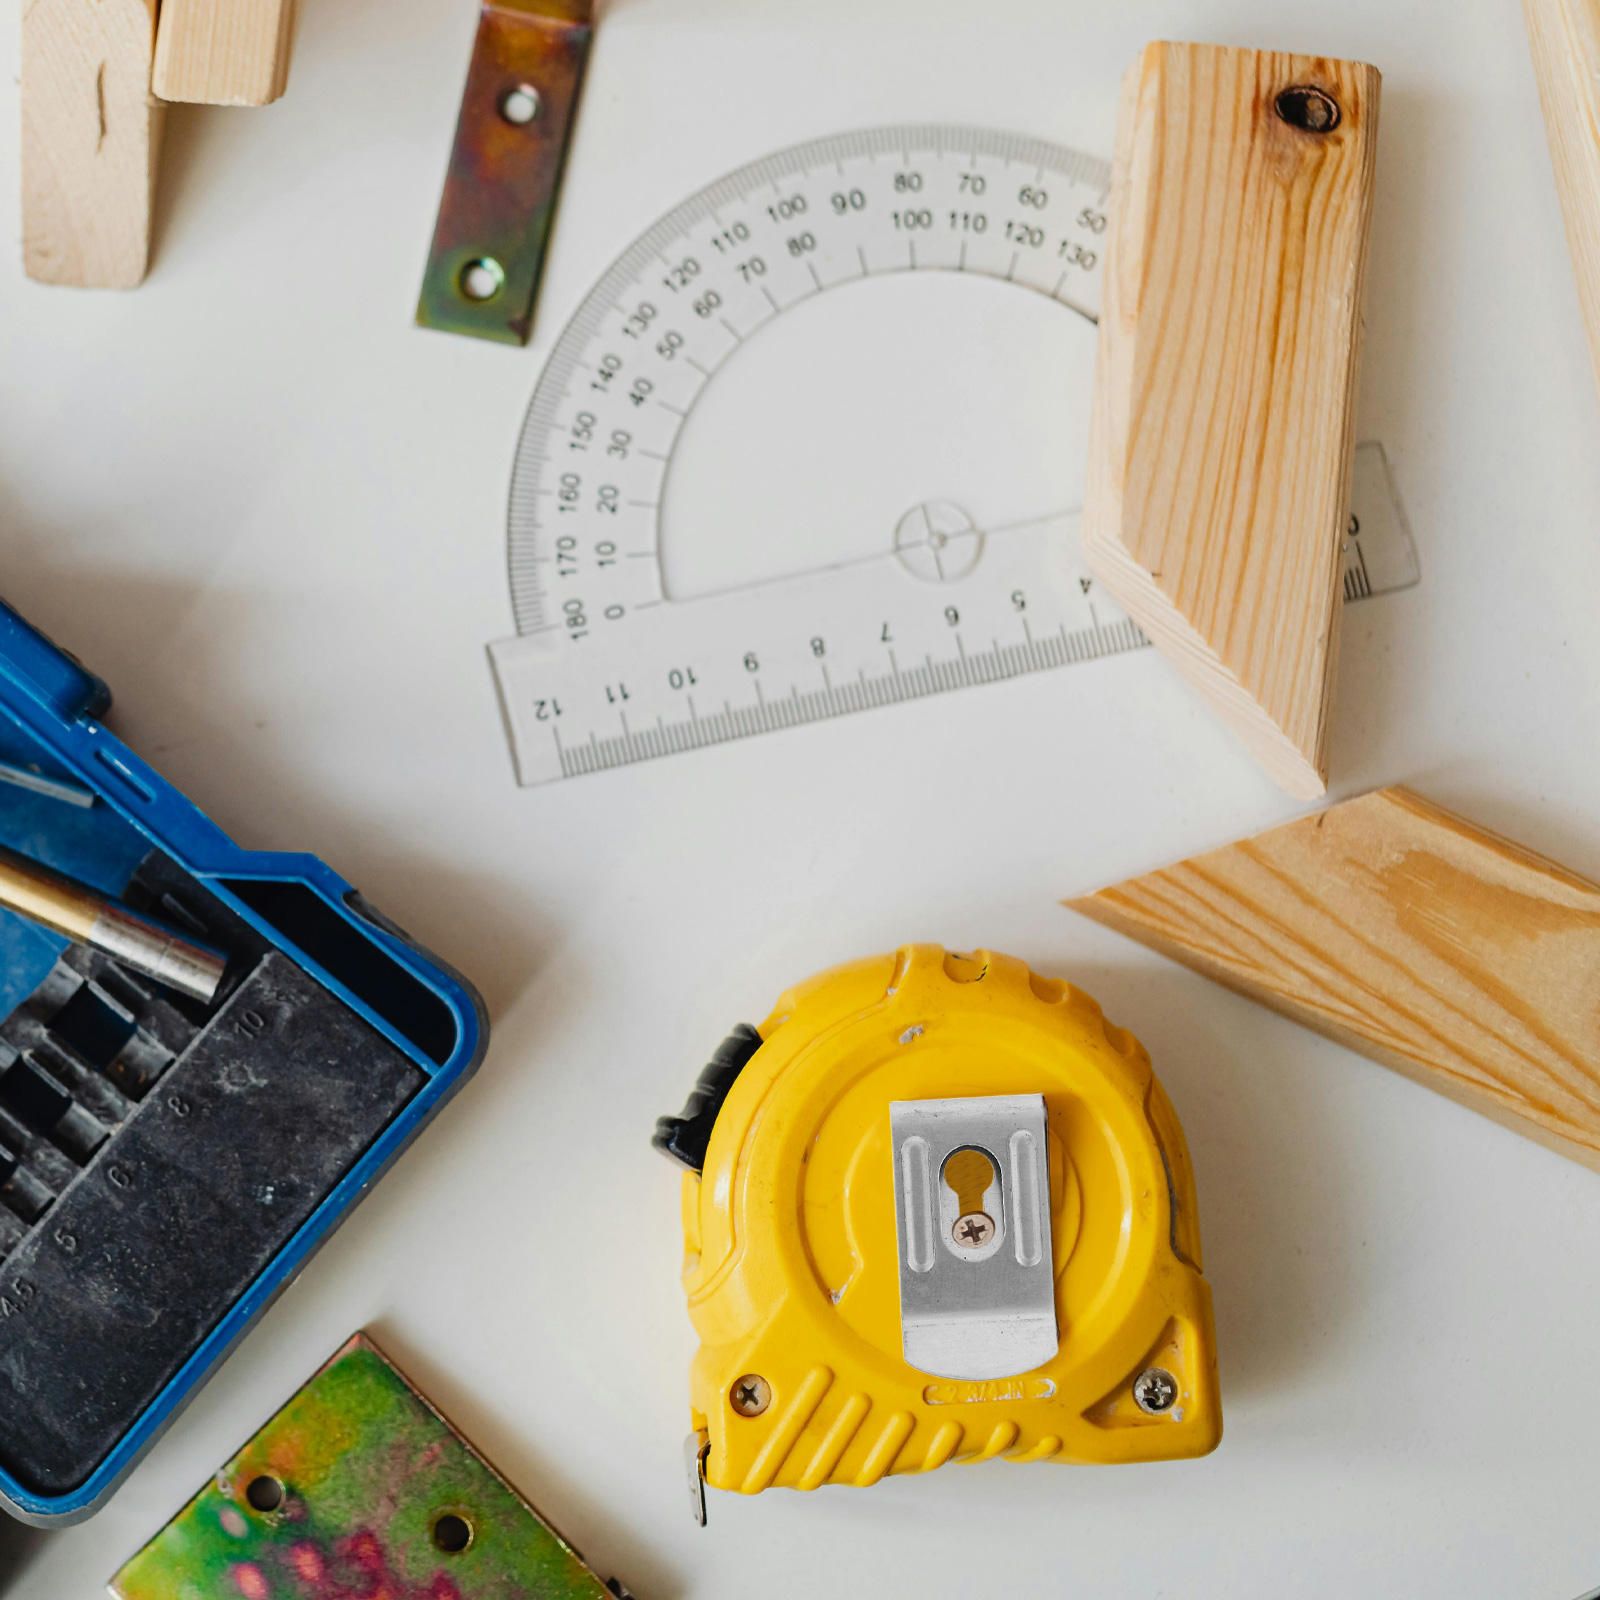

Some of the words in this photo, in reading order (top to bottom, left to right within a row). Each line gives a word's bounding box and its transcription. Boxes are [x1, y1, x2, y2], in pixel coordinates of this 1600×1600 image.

[894, 172, 923, 193] 80
[958, 173, 987, 196] 70
[767, 193, 808, 223] 100
[830, 189, 866, 216] 90
[1018, 185, 1049, 211] 60
[892, 208, 933, 231] 100
[949, 210, 988, 235] 110
[1076, 206, 1107, 235] 50
[711, 221, 750, 254] 110
[786, 231, 817, 258] 80
[1005, 219, 1045, 249] 120
[1058, 239, 1098, 272] 130
[662, 257, 701, 294] 120
[737, 256, 767, 284] 70
[692, 288, 723, 320] 60
[622, 301, 658, 340] 130
[656, 330, 685, 362] 50
[590, 353, 622, 393] 140
[628, 376, 654, 407] 40
[568, 411, 597, 452] 150
[607, 429, 632, 460] 30
[558, 472, 581, 513] 160
[597, 483, 619, 515] 20
[556, 535, 578, 577] 170
[595, 540, 617, 568] 10
[1079, 576, 1092, 595] 4
[604, 603, 626, 621] 0
[1010, 589, 1027, 612] 5
[563, 598, 589, 641] 180
[944, 605, 960, 627] 6
[880, 621, 893, 643] 7
[809, 636, 826, 658] 8
[743, 652, 760, 673] 9
[668, 667, 698, 691] 10
[604, 682, 630, 704] 11
[533, 698, 563, 722] 12
[233, 1008, 265, 1039] 10
[168, 1096, 189, 1118] 8
[109, 1165, 133, 1190] 6
[54, 1227, 77, 1252] 5
